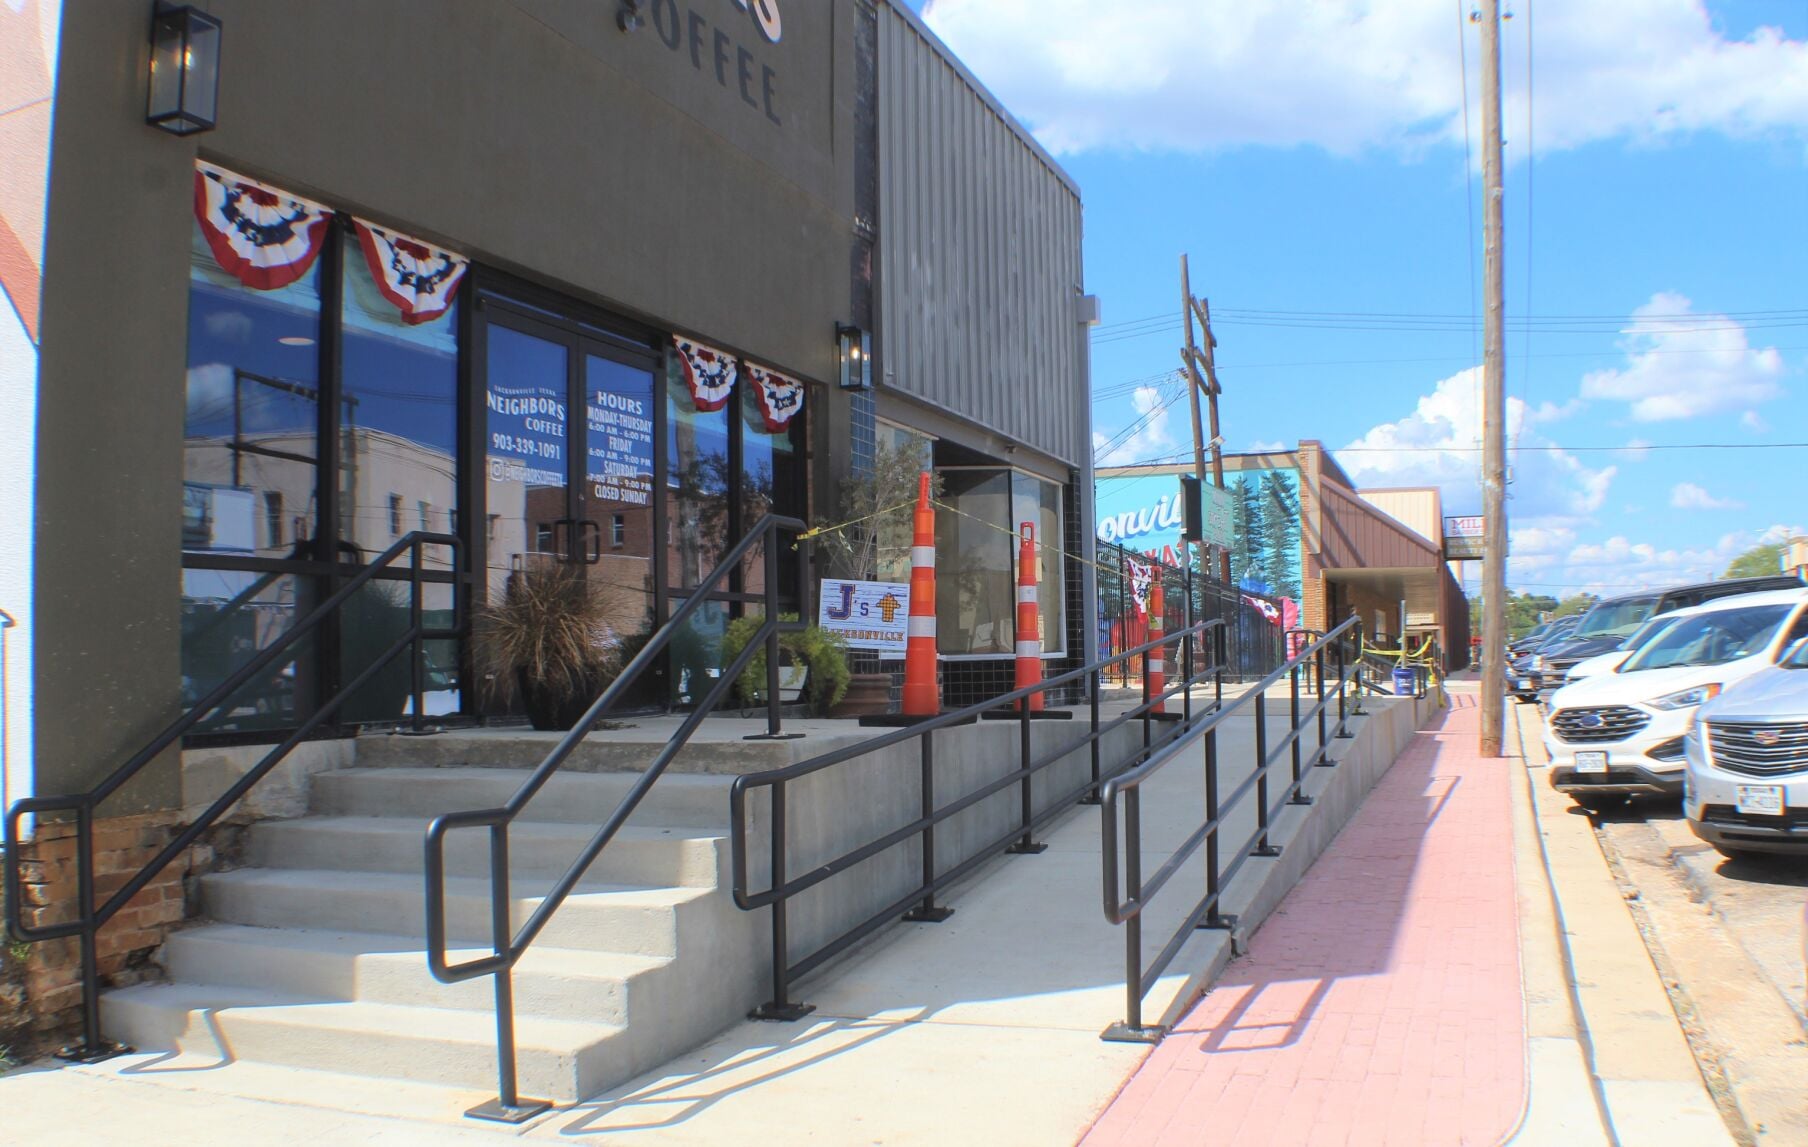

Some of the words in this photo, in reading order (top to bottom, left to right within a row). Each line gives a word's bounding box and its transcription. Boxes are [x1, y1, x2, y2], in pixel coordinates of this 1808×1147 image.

[636, 0, 782, 126] OFFEE
[486, 390, 565, 421] NEIGHBORS
[597, 391, 643, 415] HOURS
[525, 416, 564, 437] COFFEE
[587, 405, 652, 433] MONDAY-THURSDAY
[606, 425, 618, 436] AM
[640, 433, 651, 443] PM
[609, 435, 633, 454] FRIDAY
[492, 432, 560, 460] 903-339-1091
[606, 450, 618, 460] AM
[640, 457, 651, 467] PM
[604, 460, 637, 479] SATURDAY
[606, 476, 618, 486] AM
[640, 482, 652, 491] PM
[594, 484, 620, 500] CLOSED
[620, 487, 648, 505] SUNDAY
[822, 626, 904, 642] KSONVILLE
